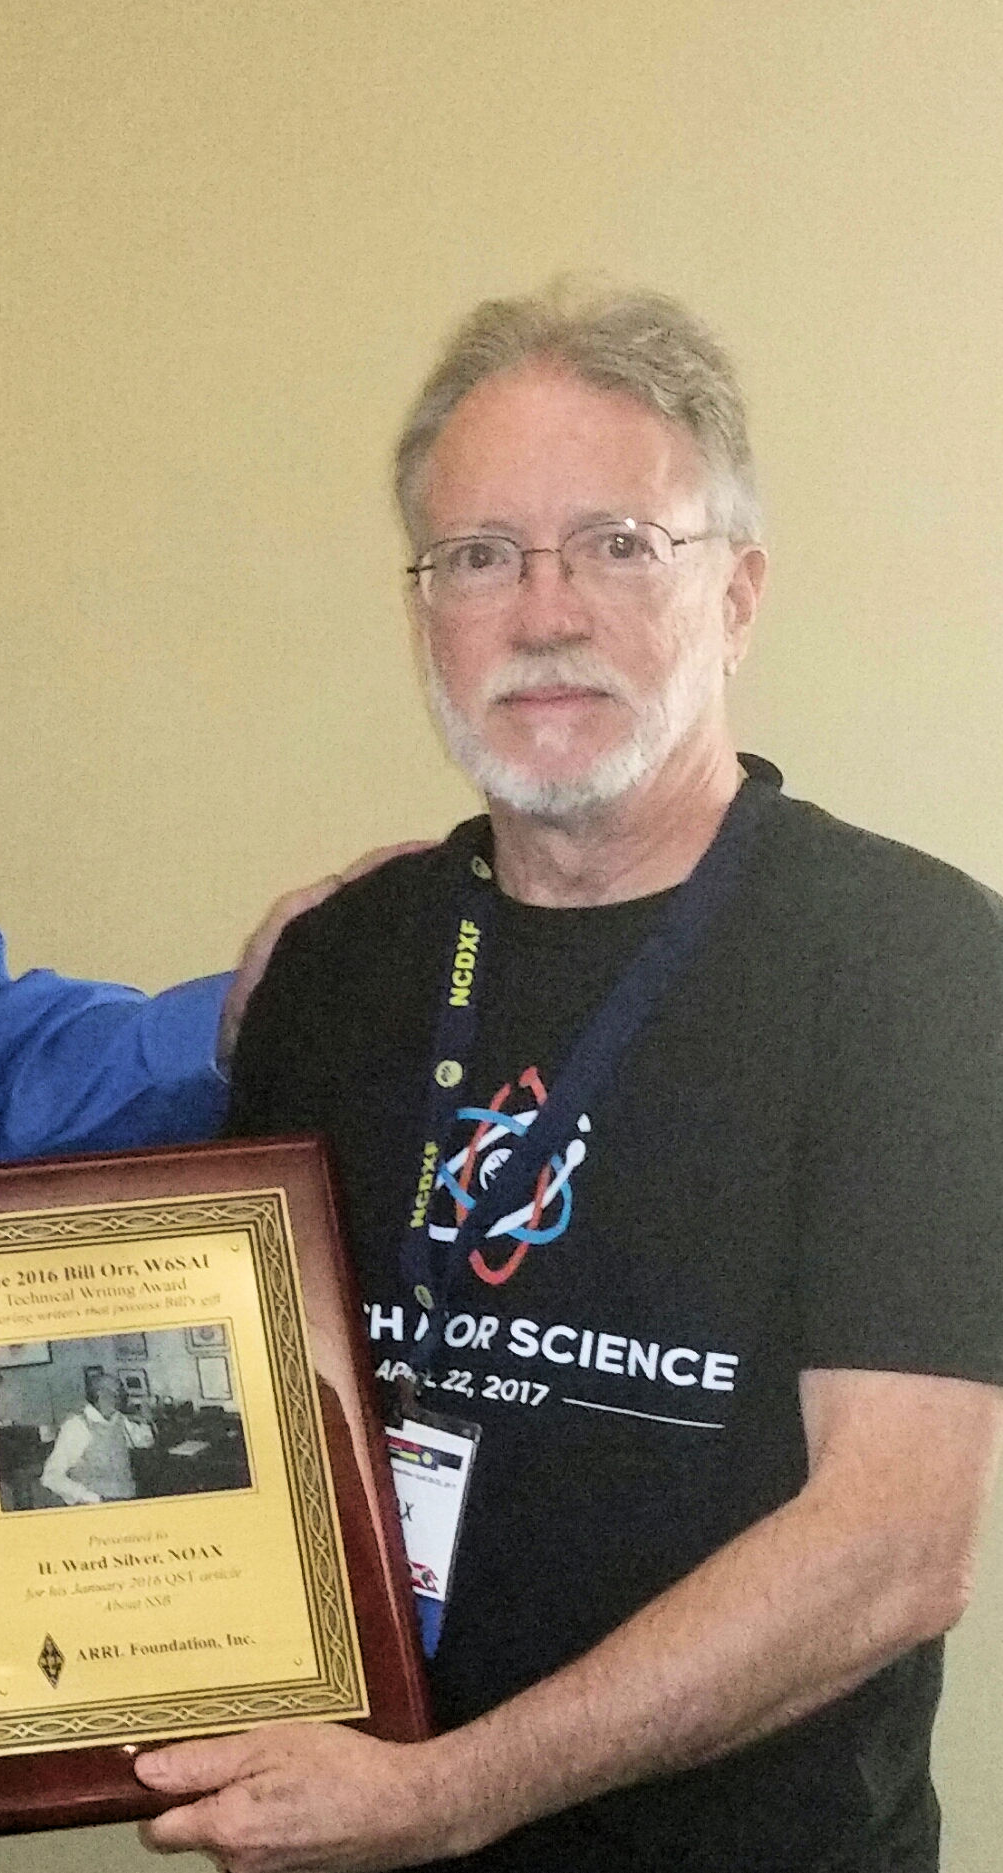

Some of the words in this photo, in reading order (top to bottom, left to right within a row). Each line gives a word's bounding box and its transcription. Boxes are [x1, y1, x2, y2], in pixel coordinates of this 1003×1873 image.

[449, 918, 481, 1007] NCDXF
[409, 1141, 439, 1229] NCDXF
[16, 1268, 59, 1287] 2016
[64, 1264, 96, 1282] Bill
[100, 1262, 140, 1278] Orr,
[142, 1253, 210, 1273] W6SAI
[5, 1287, 76, 1308] Technical
[79, 1283, 136, 1300] Writing
[139, 1276, 188, 1295] Award
[507, 1318, 739, 1391] SCIENCE
[440, 1369, 475, 1398] 22,
[481, 1374, 550, 1407] 2017
[61, 1554, 108, 1573] Ward
[111, 1551, 165, 1570] Silver,
[76, 1645, 125, 1663] ARRL
[128, 1636, 224, 1657] Foundation,
[226, 1632, 258, 1648] Inc.
